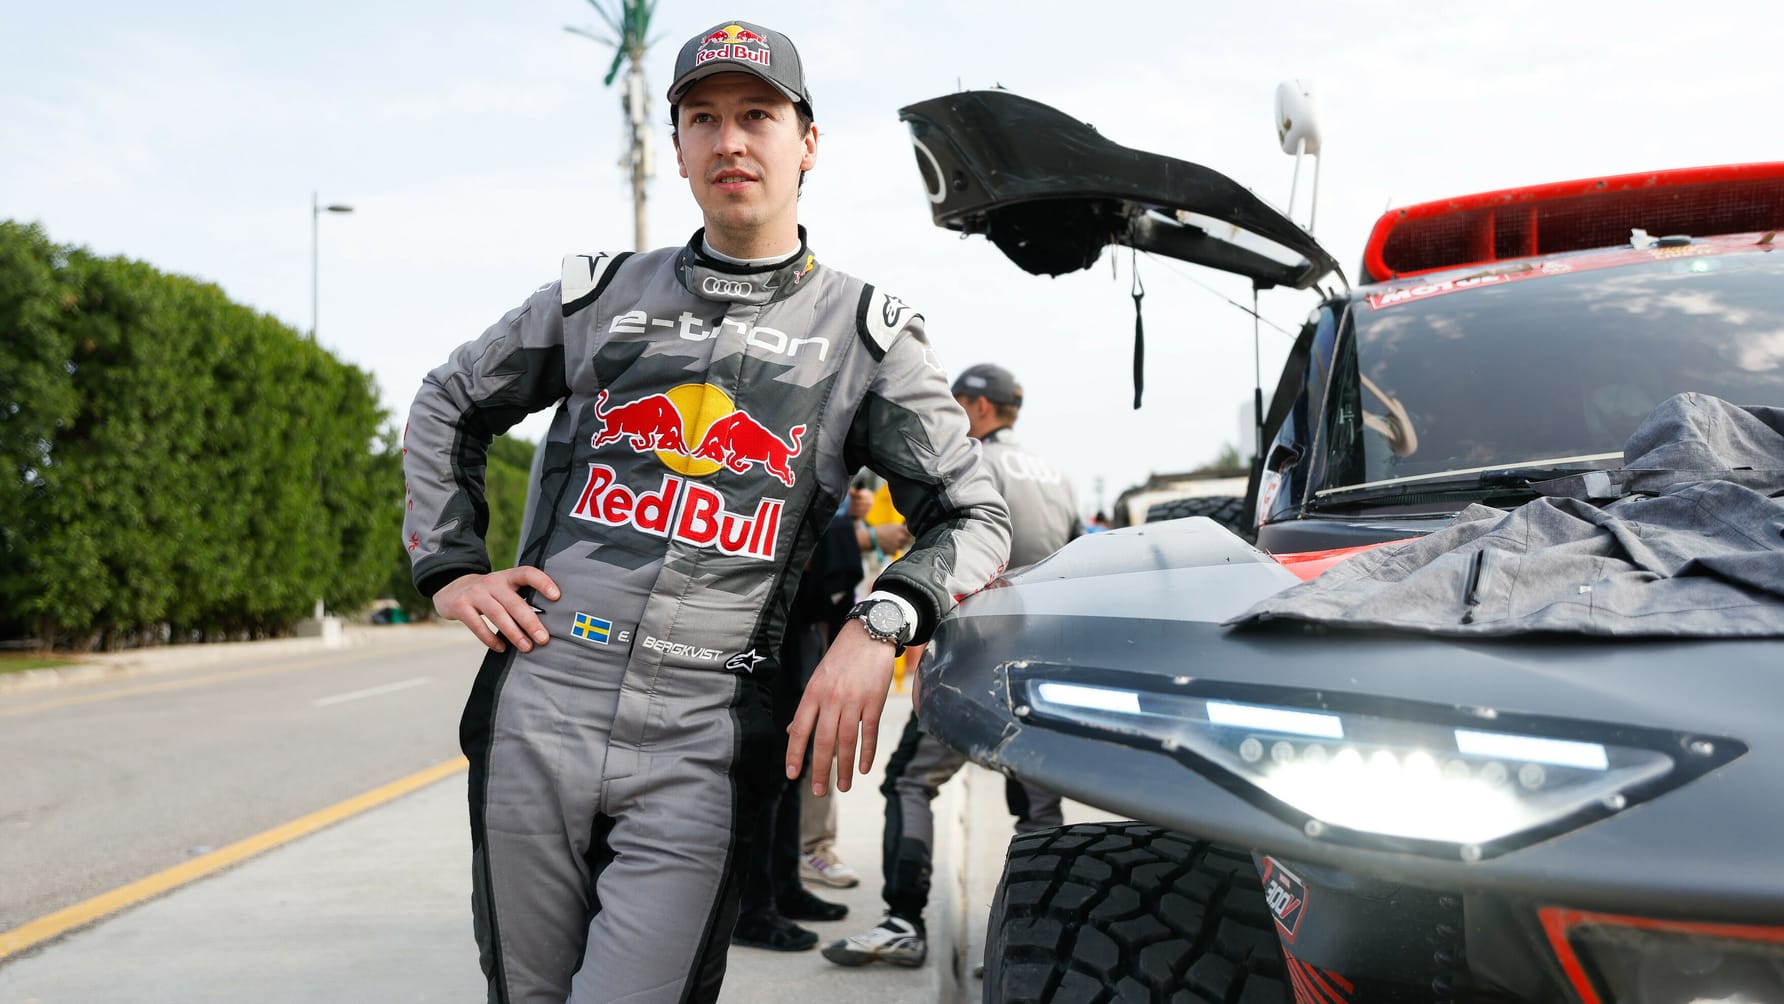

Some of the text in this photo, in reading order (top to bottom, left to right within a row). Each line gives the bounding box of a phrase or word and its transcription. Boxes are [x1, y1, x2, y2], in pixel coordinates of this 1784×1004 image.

[696, 44, 771, 66] Red Bull
[608, 310, 830, 362] e-tron
[569, 463, 785, 561] Red Bull
[642, 636, 723, 662] BERGKVIST
[1265, 879, 1301, 919] 300V
